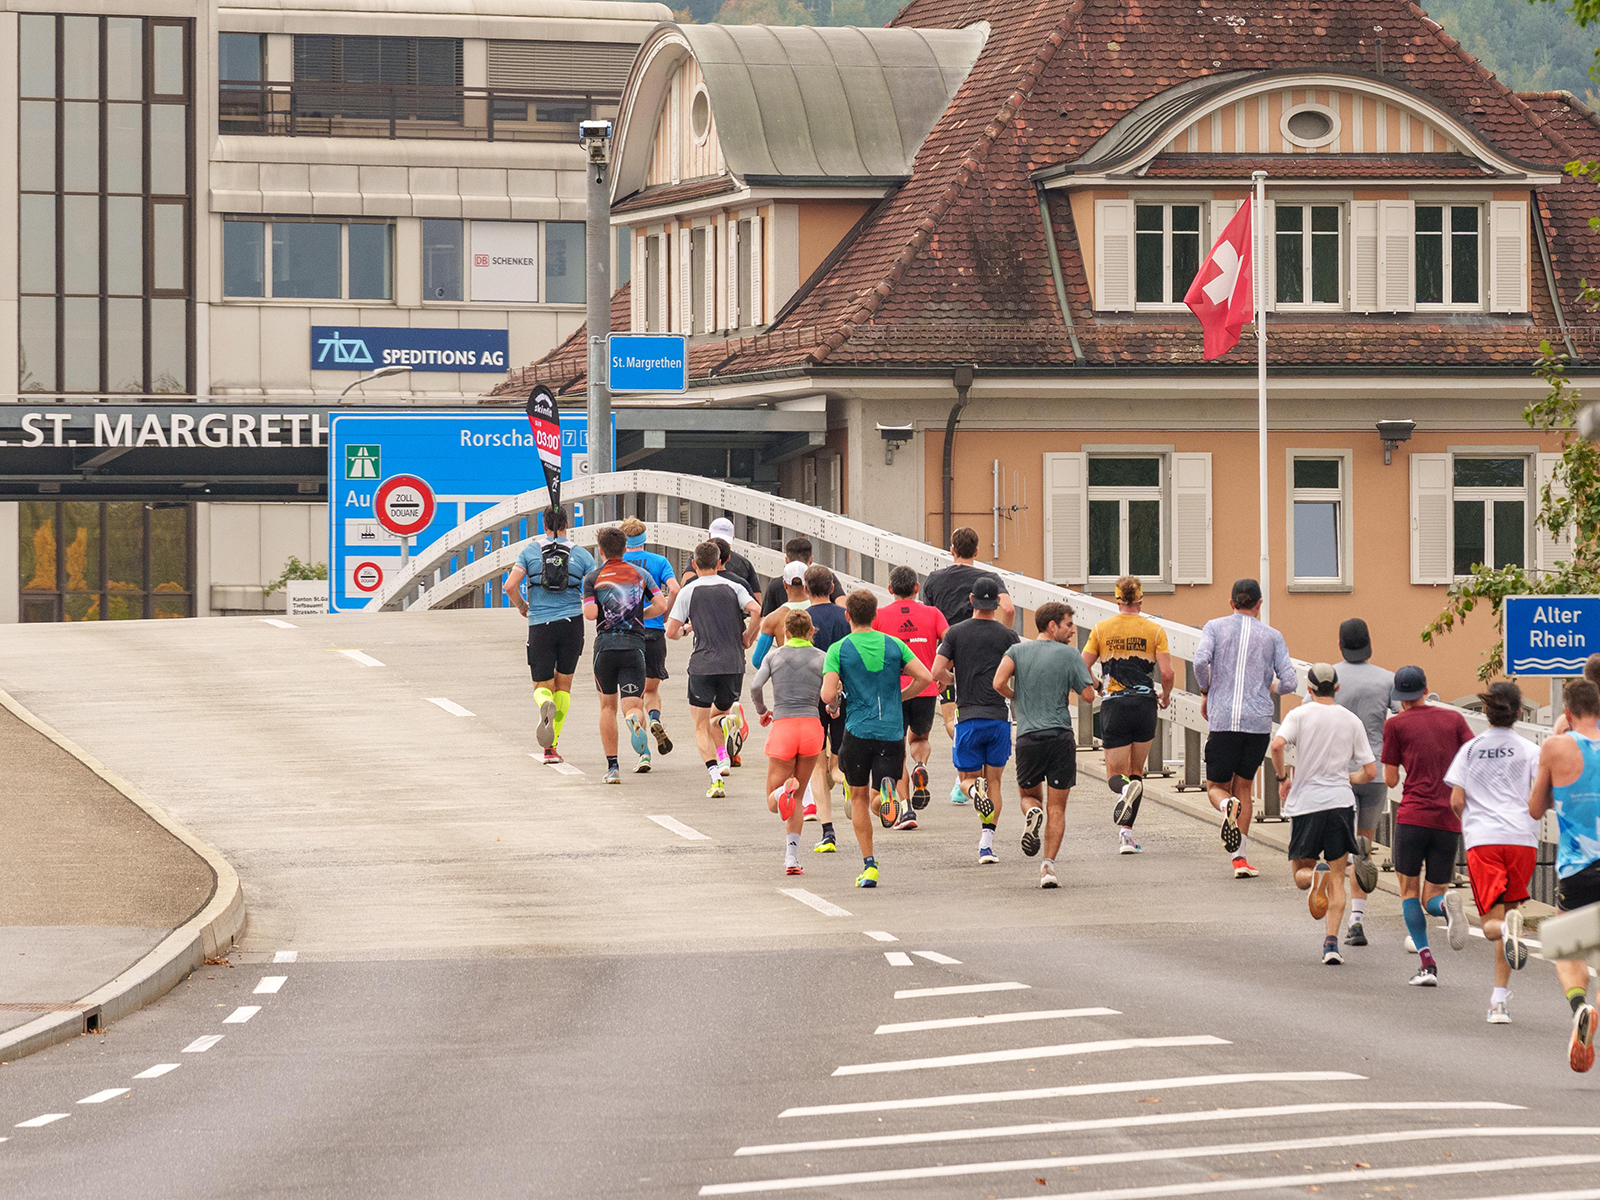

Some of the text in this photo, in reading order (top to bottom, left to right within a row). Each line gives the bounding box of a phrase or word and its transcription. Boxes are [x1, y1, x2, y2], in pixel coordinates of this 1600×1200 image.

[475, 256, 534, 266] DB SCHENKER
[382, 349, 476, 365] SPEDITIONS
[480, 351, 504, 366] AG
[21, 413, 77, 447] ST.
[565, 432, 573, 444] 7
[345, 490, 371, 508] Au
[396, 494, 413, 503] ZOLL
[391, 509, 419, 518] DOUANE
[1533, 606, 1582, 624] Alter
[1530, 630, 1586, 648] Rhein
[1479, 747, 1515, 760] ZEISS
